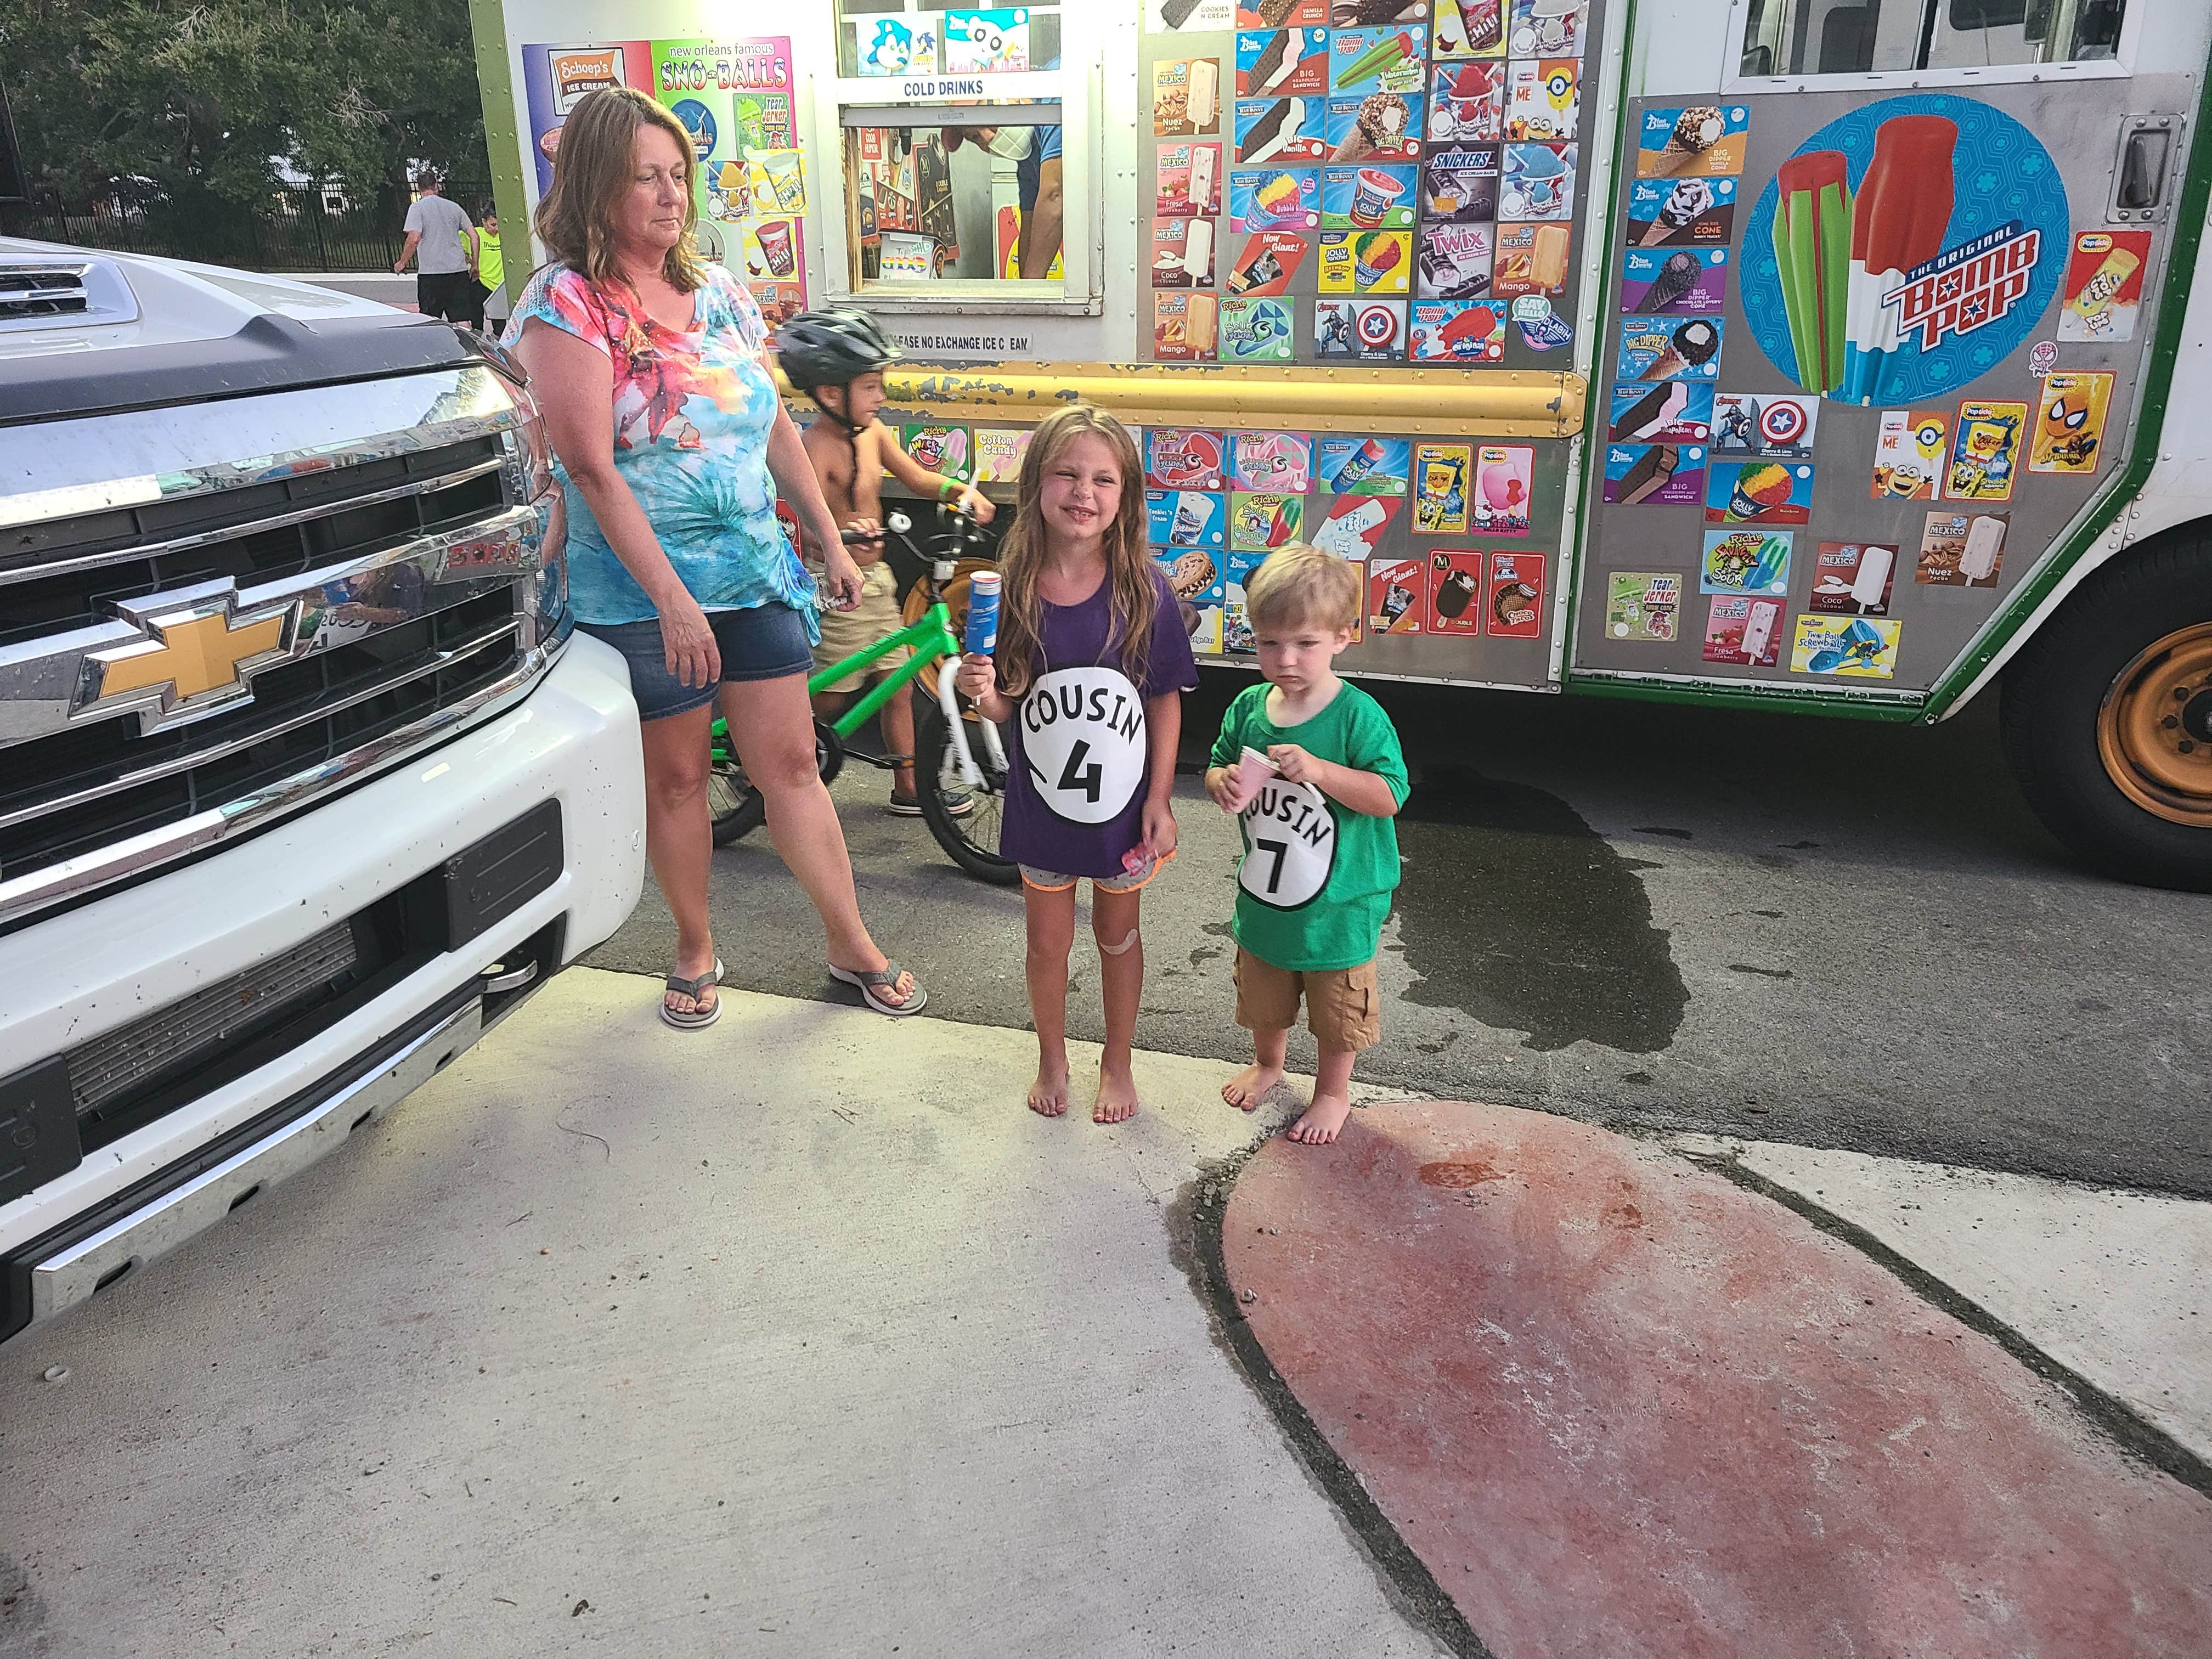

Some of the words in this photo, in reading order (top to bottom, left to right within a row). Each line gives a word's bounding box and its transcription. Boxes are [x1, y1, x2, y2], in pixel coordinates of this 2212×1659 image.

[670, 48, 691, 57] new
[695, 44, 731, 56] orleans
[735, 43, 774, 54] famous
[561, 60, 608, 79] Schoep's
[661, 57, 787, 91] SNO-BALLS
[1299, 70, 1314, 78] BIG
[1384, 67, 1419, 80] Watermelon
[1158, 74, 1187, 85] MEXICO
[566, 83, 580, 93] ICE
[582, 82, 610, 91] CREAM
[904, 81, 935, 97] COLD
[939, 80, 983, 95] DRINKS
[1516, 87, 1531, 101] ME
[1163, 117, 1183, 127] Nuez
[1646, 114, 1666, 129] Blue
[1160, 157, 1189, 167] MEXICO
[1434, 152, 1489, 168] SNICKERS
[1635, 185, 1655, 200] Blue
[1166, 200, 1183, 208] Fresa
[1359, 201, 1378, 211] JOLLY
[1155, 230, 1183, 240] MEXICO
[1694, 226, 1722, 234] CONE
[1262, 234, 1280, 245] Now
[1426, 227, 1485, 255] Twix
[1500, 237, 1533, 247] MEXICO
[1271, 241, 1300, 252] Giant!
[1325, 248, 1347, 257] JOLLY
[1909, 263, 1932, 280] THE
[1937, 225, 2014, 269] ORIGINAL
[1882, 230, 2040, 324] BOMB
[1499, 282, 1530, 292] Mango
[2090, 278, 2104, 301] UPS
[2097, 272, 2112, 295] POP
[1158, 303, 1186, 313] MEXICO
[1519, 298, 1547, 309] SAY
[1517, 308, 1545, 318] HELLO
[1898, 271, 2028, 351] POP
[921, 336, 933, 349] NO
[935, 336, 980, 350] EXCHANGE
[983, 337, 996, 350] ICE
[1626, 337, 1639, 349] BIG
[1640, 334, 1668, 351] DIPPER
[1159, 345, 1186, 354] Mango
[2051, 379, 2078, 388] Popsicle
[1965, 408, 1991, 416] Popsicle
[979, 433, 1014, 445] Cotton
[1882, 435, 1899, 449] ME
[911, 439, 944, 458] WACKY
[983, 444, 1017, 459] Candy
[1423, 450, 1442, 458] Popsicle
[1252, 495, 1280, 507] Rich's
[1733, 497, 1754, 511] JOLLY
[1244, 504, 1269, 521] SOUR
[1731, 503, 1752, 516] rancher
[1929, 526, 1966, 535] MEXICO
[1730, 533, 1763, 546] Rich's
[1436, 556, 1448, 567] M
[1821, 555, 1857, 566] MEXICO
[1381, 568, 1397, 582] Now
[1392, 565, 1419, 583] Giant!
[1712, 567, 1744, 585] SOUR
[1927, 567, 1952, 576] Nuez
[1821, 596, 1842, 604] Coco
[1233, 603, 1243, 614] GO!
[1508, 610, 1533, 619] CHOCO
[1713, 607, 1747, 618] MEXICO
[1714, 646, 1734, 655] Fresa
[1026, 685, 1144, 746] COUSIN
[1057, 738, 1103, 804] 4
[1256, 837, 1289, 894] 7
